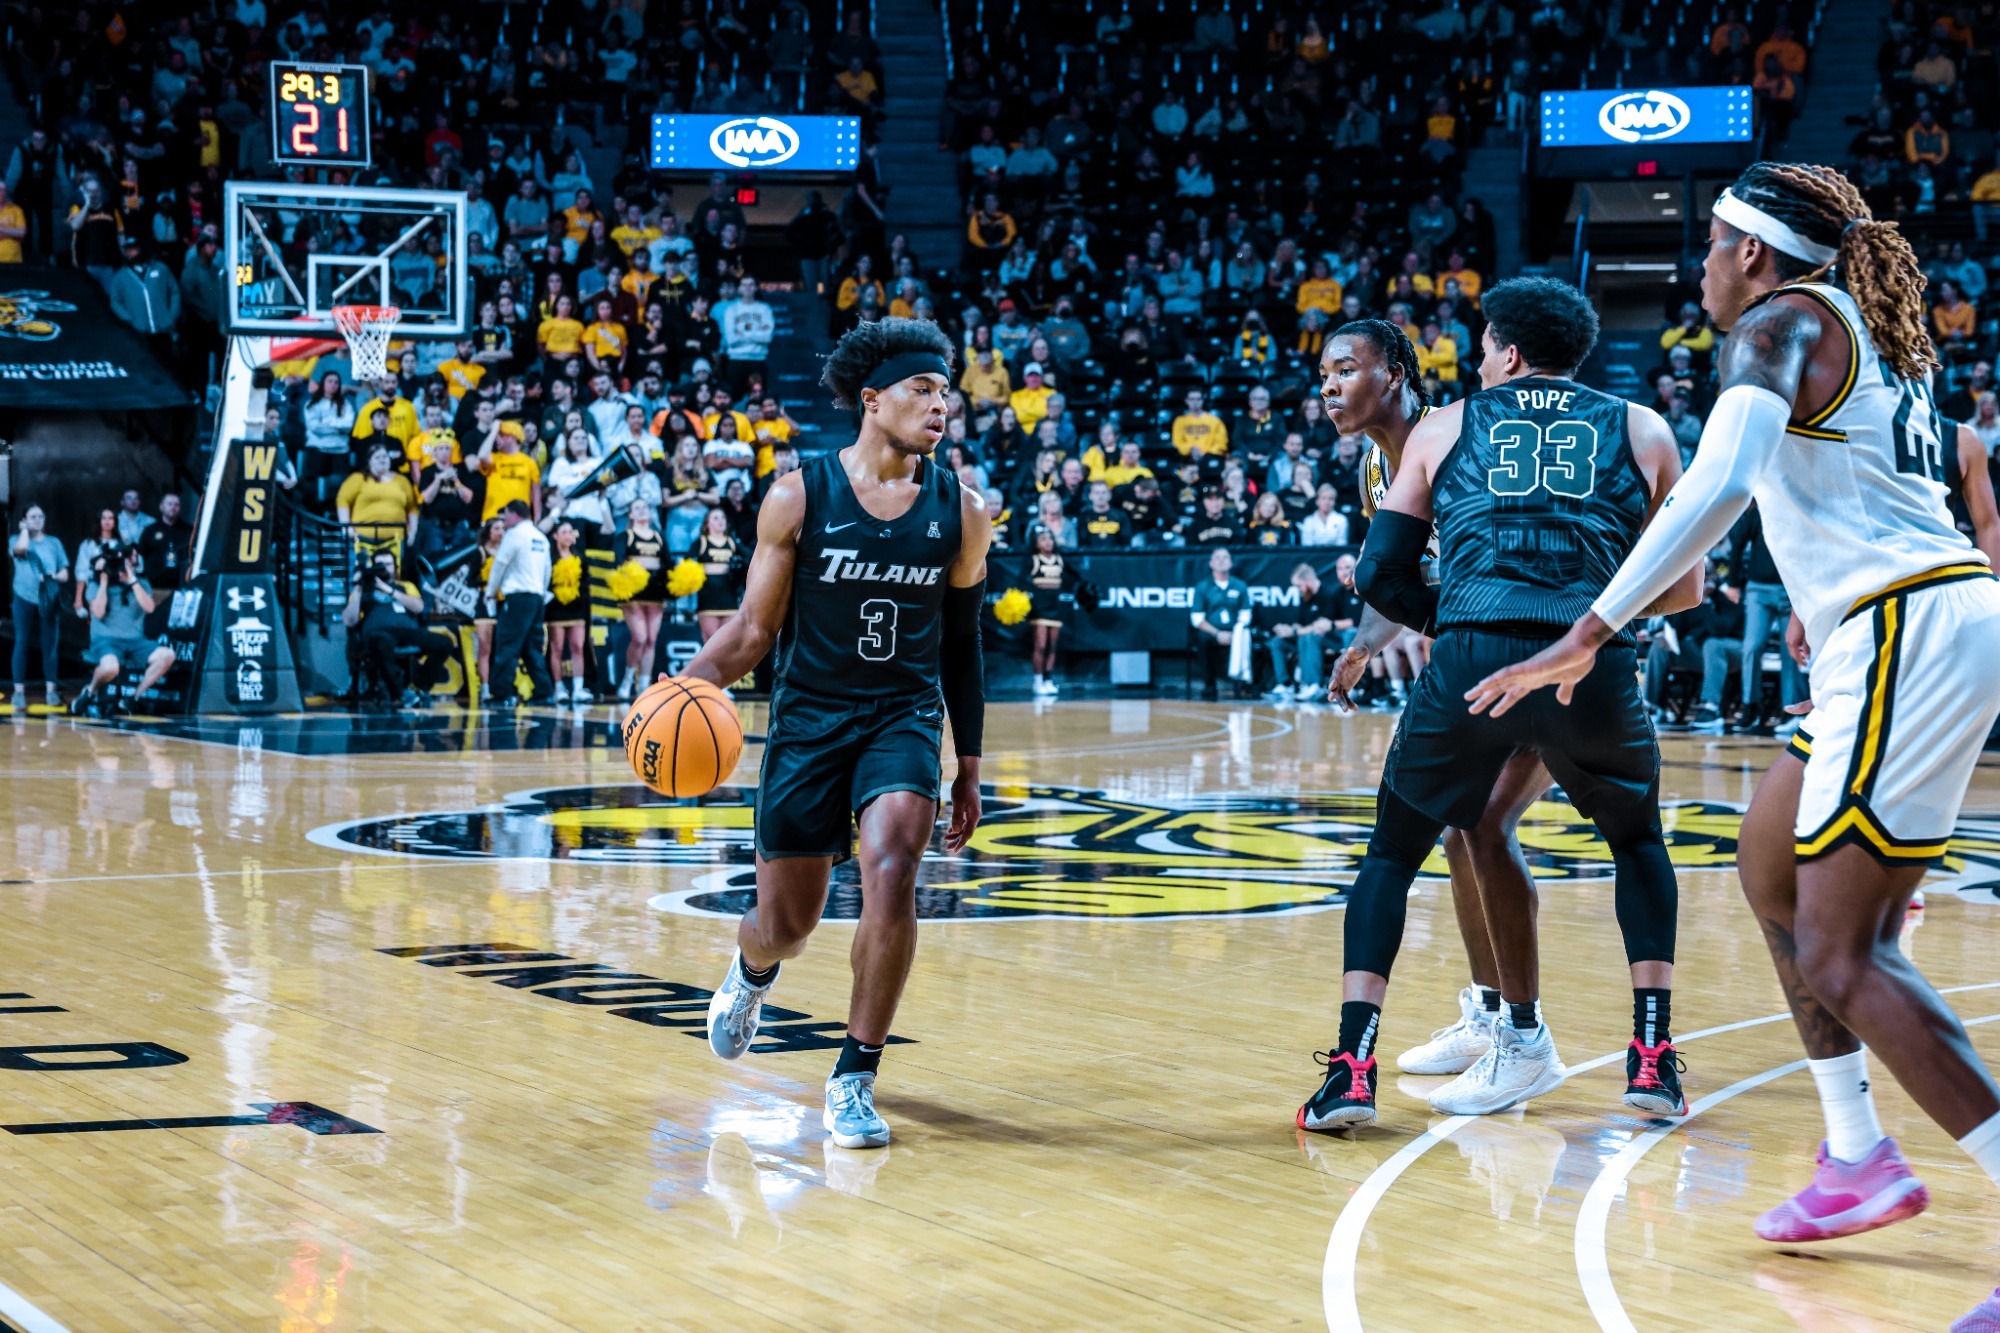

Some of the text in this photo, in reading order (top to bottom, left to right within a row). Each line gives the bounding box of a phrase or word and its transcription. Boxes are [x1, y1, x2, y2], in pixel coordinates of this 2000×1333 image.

[281, 73, 339, 104] 29.3
[292, 104, 348, 153] 21
[1515, 389, 1576, 412] POPE
[1487, 420, 1598, 500] 33
[238, 446, 276, 562] WSU
[1499, 530, 1579, 552] NOLA BUILT
[818, 548, 944, 586] TULANE
[858, 599, 898, 661] 3
[236, 682, 263, 692] TACO
[238, 691, 264, 701] BELL
[643, 740, 661, 787] NCAA
